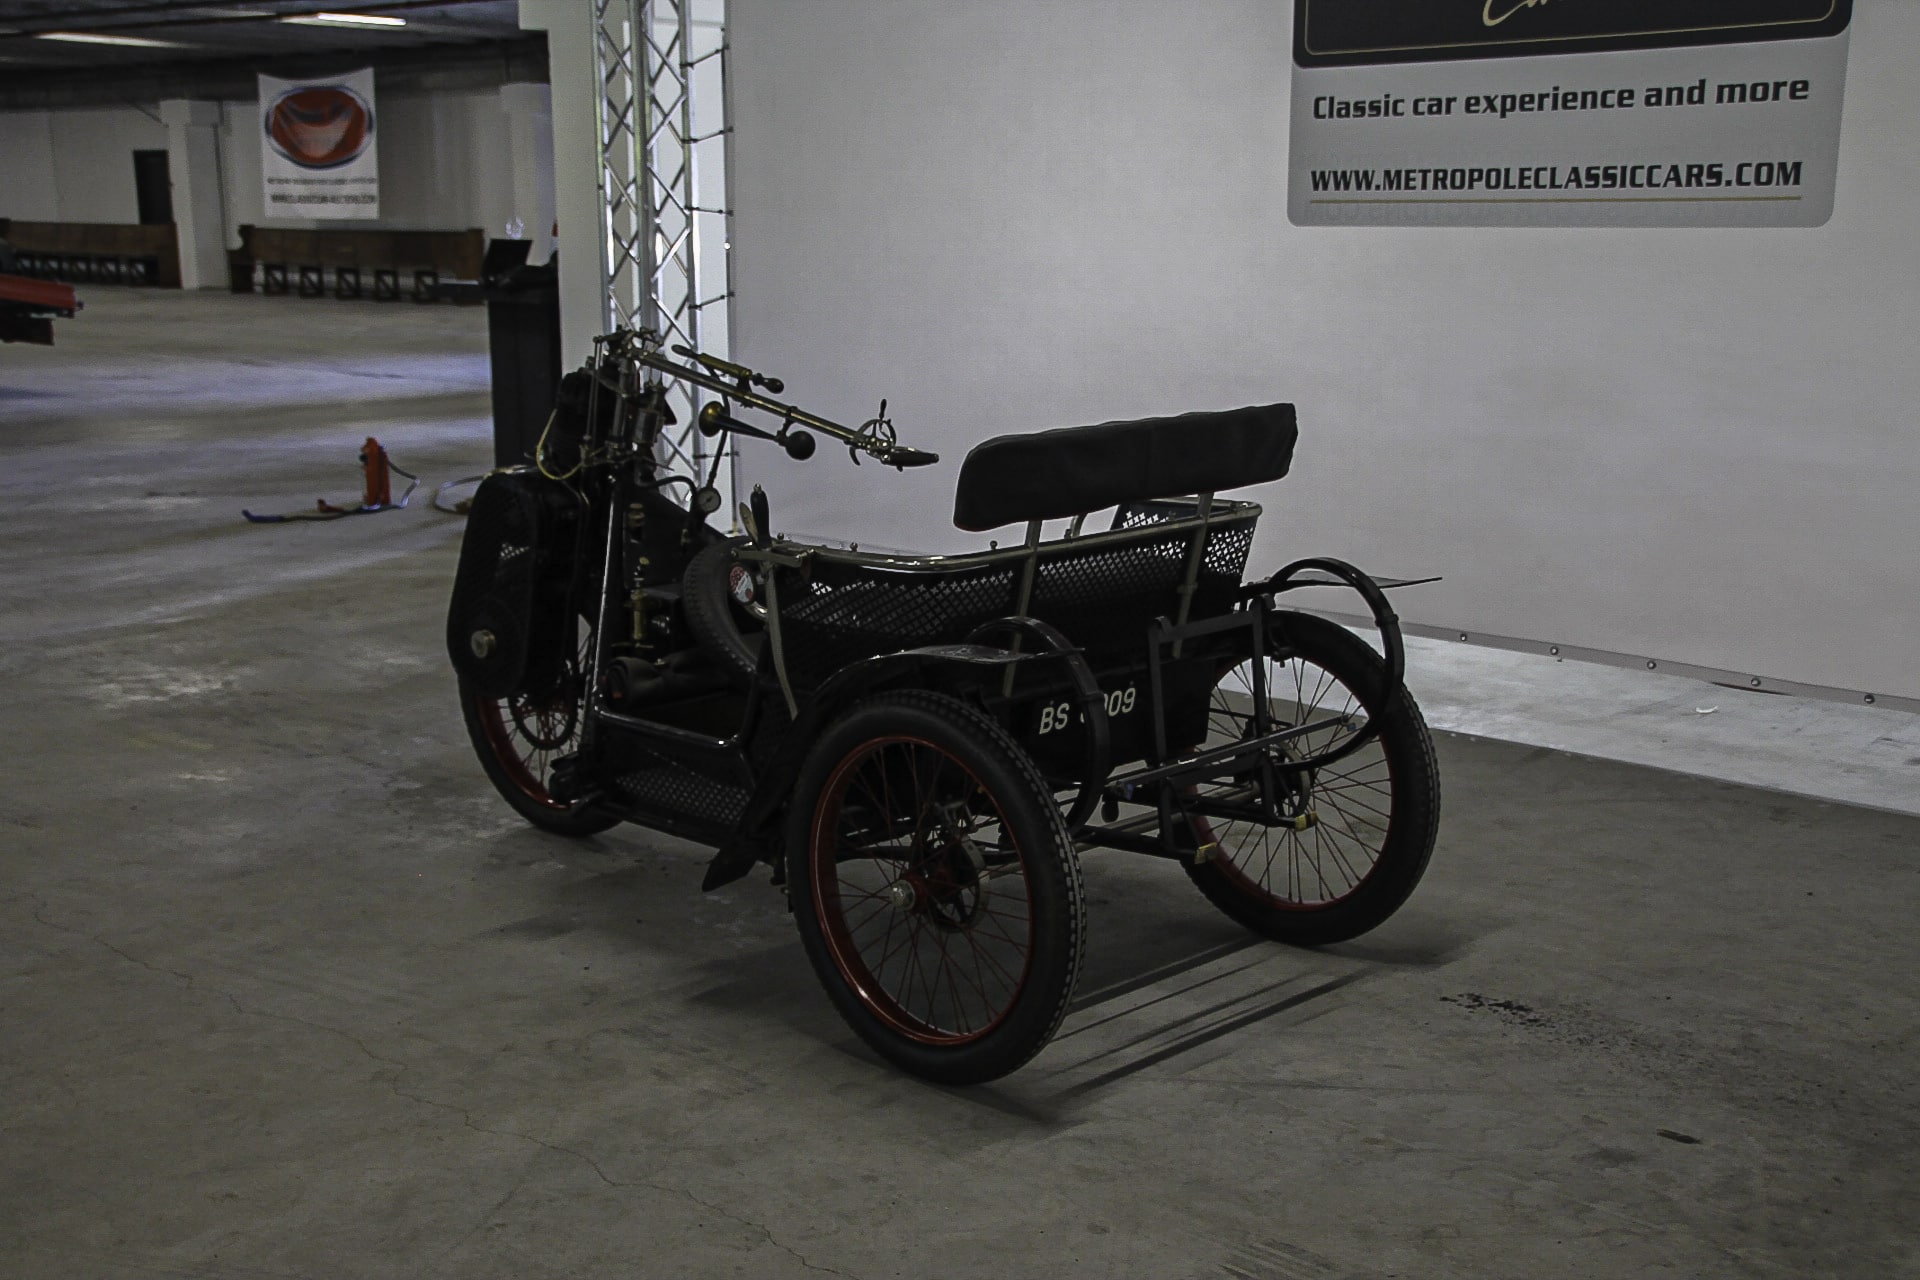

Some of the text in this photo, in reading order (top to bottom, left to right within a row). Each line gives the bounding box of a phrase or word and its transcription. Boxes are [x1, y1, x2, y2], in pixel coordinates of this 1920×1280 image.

[1313, 79, 1810, 119] Classic car experience and more
[1310, 161, 1803, 192] WWW.METROPOLECLASSICCARS.COM
[1039, 702, 1070, 734] BS
